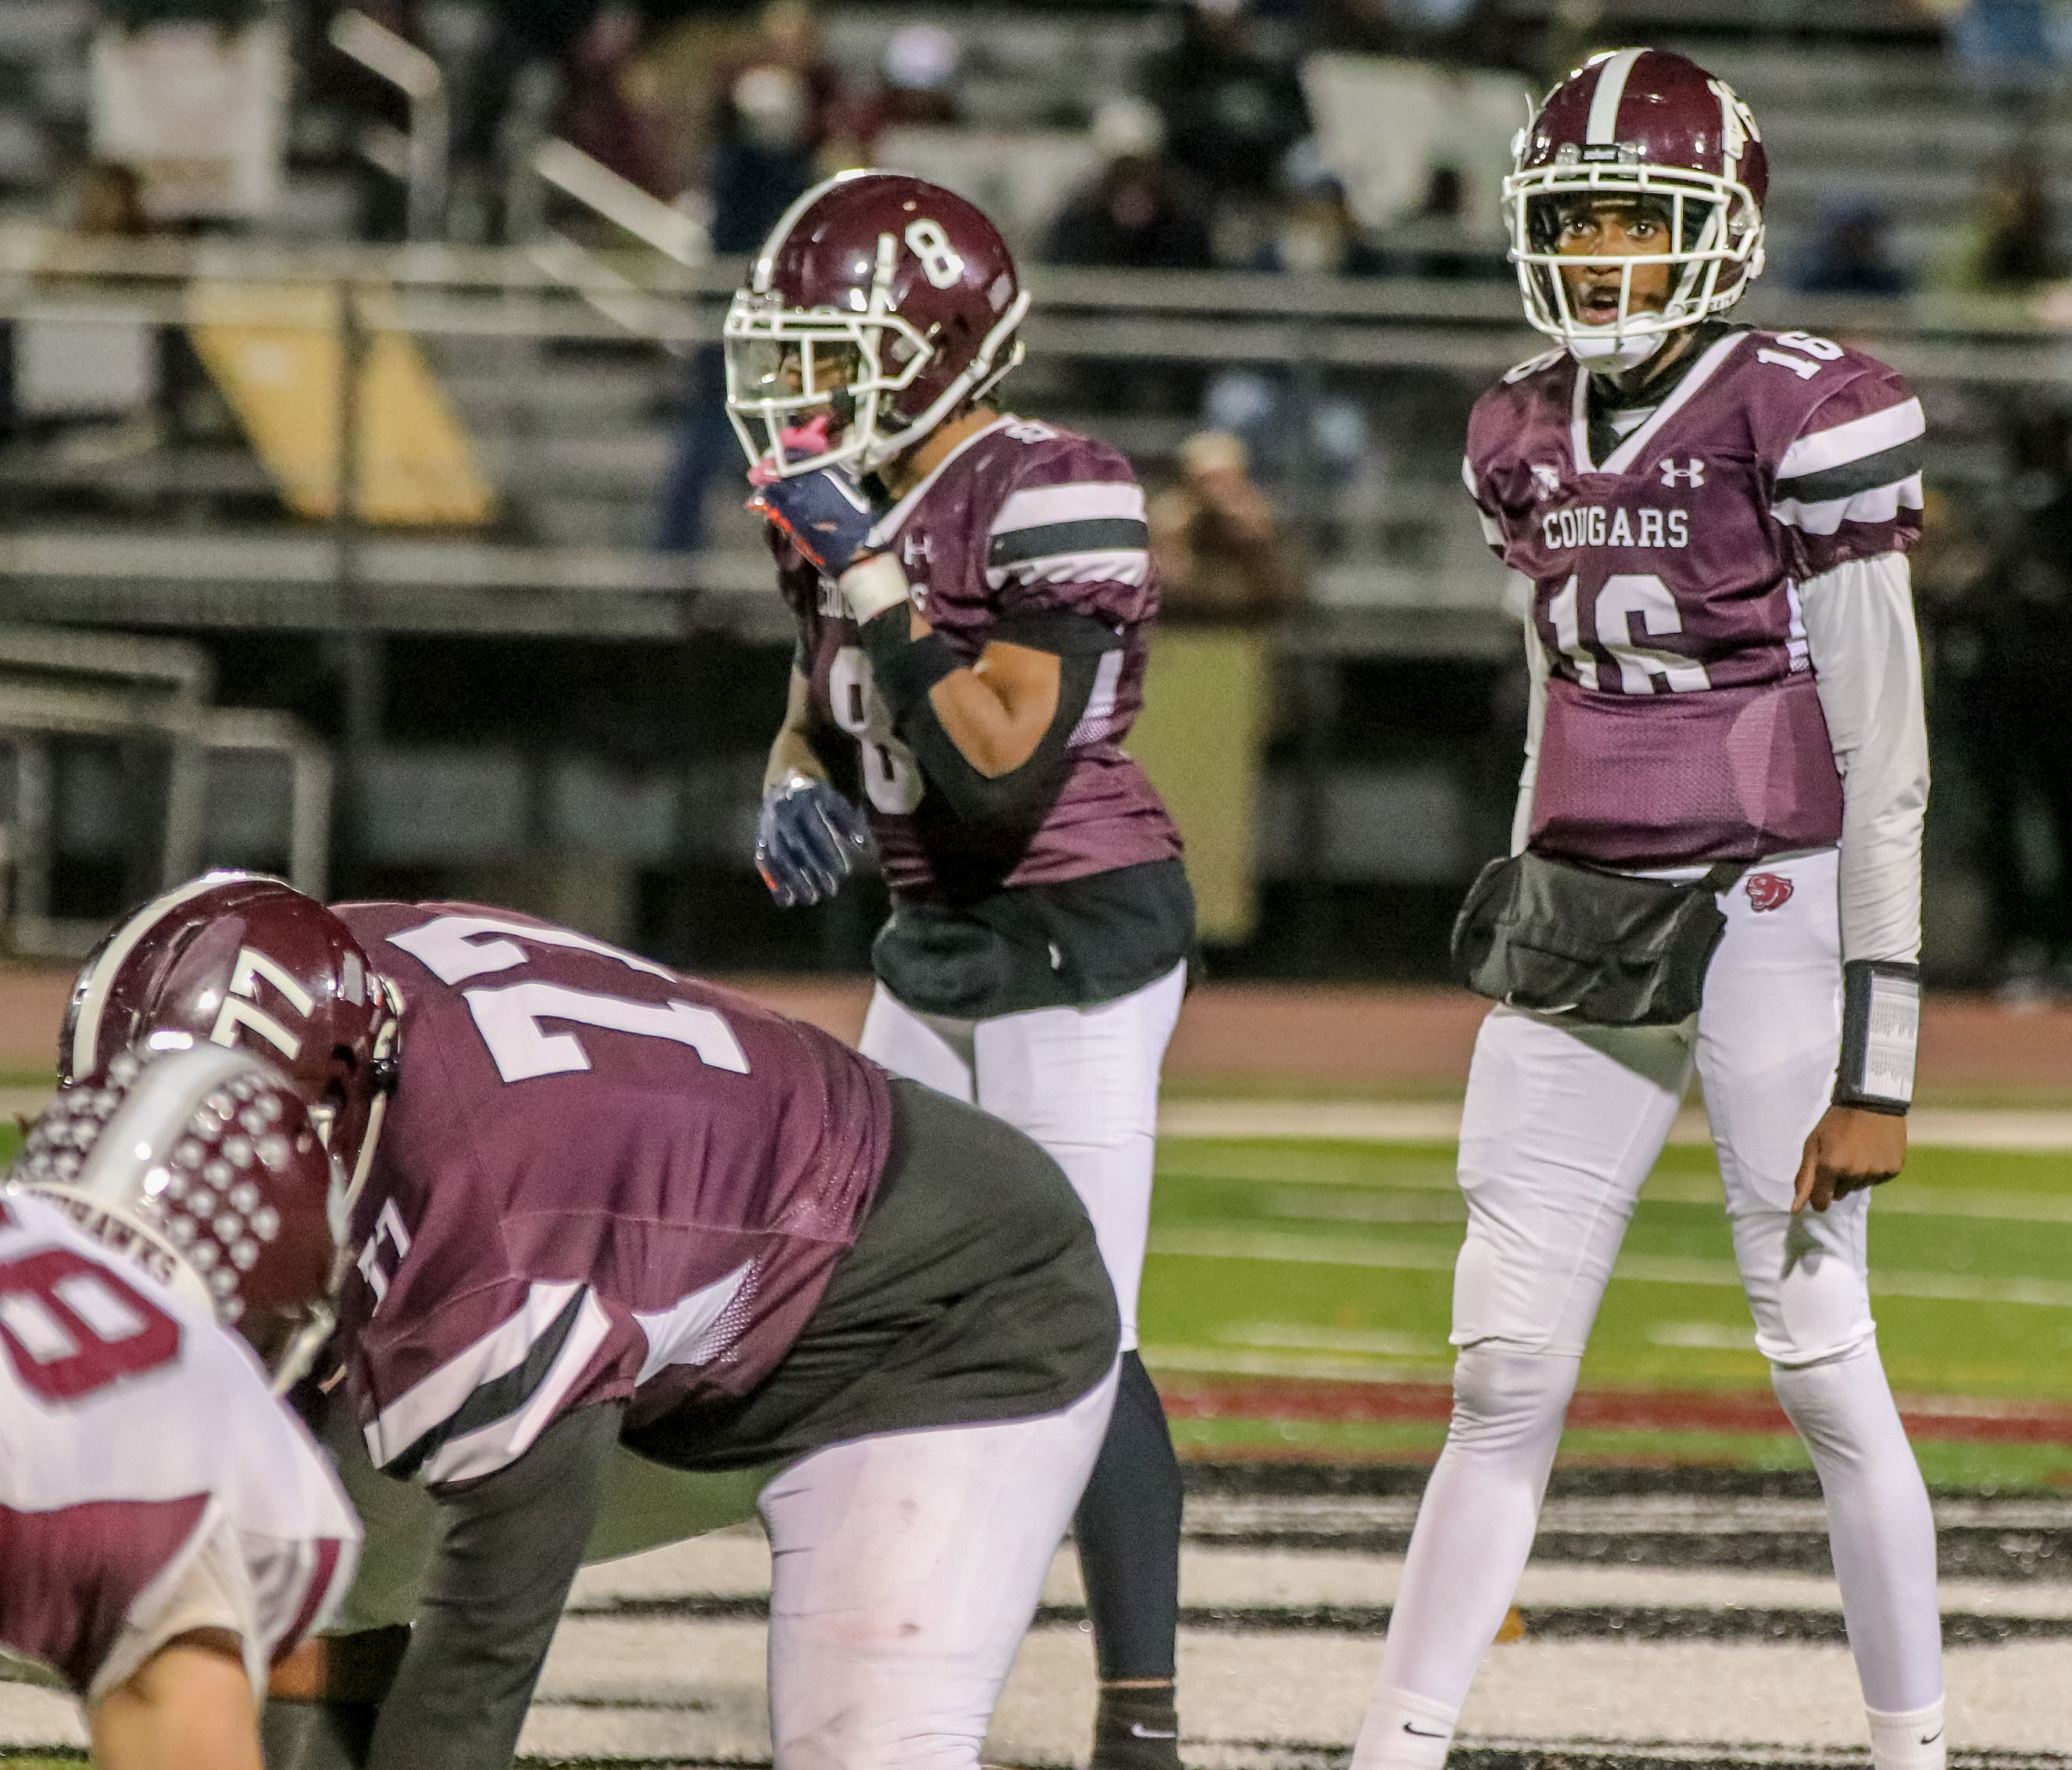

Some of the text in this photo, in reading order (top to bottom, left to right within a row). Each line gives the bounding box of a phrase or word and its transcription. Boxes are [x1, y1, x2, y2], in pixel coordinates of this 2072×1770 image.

[905, 218, 964, 290] 8
[1756, 331, 1845, 381] 16
[1542, 506, 1688, 549] COUGARS
[1549, 574, 1711, 695] 16
[829, 647, 925, 814] 8
[210, 948, 314, 1060] 77
[385, 917, 751, 1083] 77
